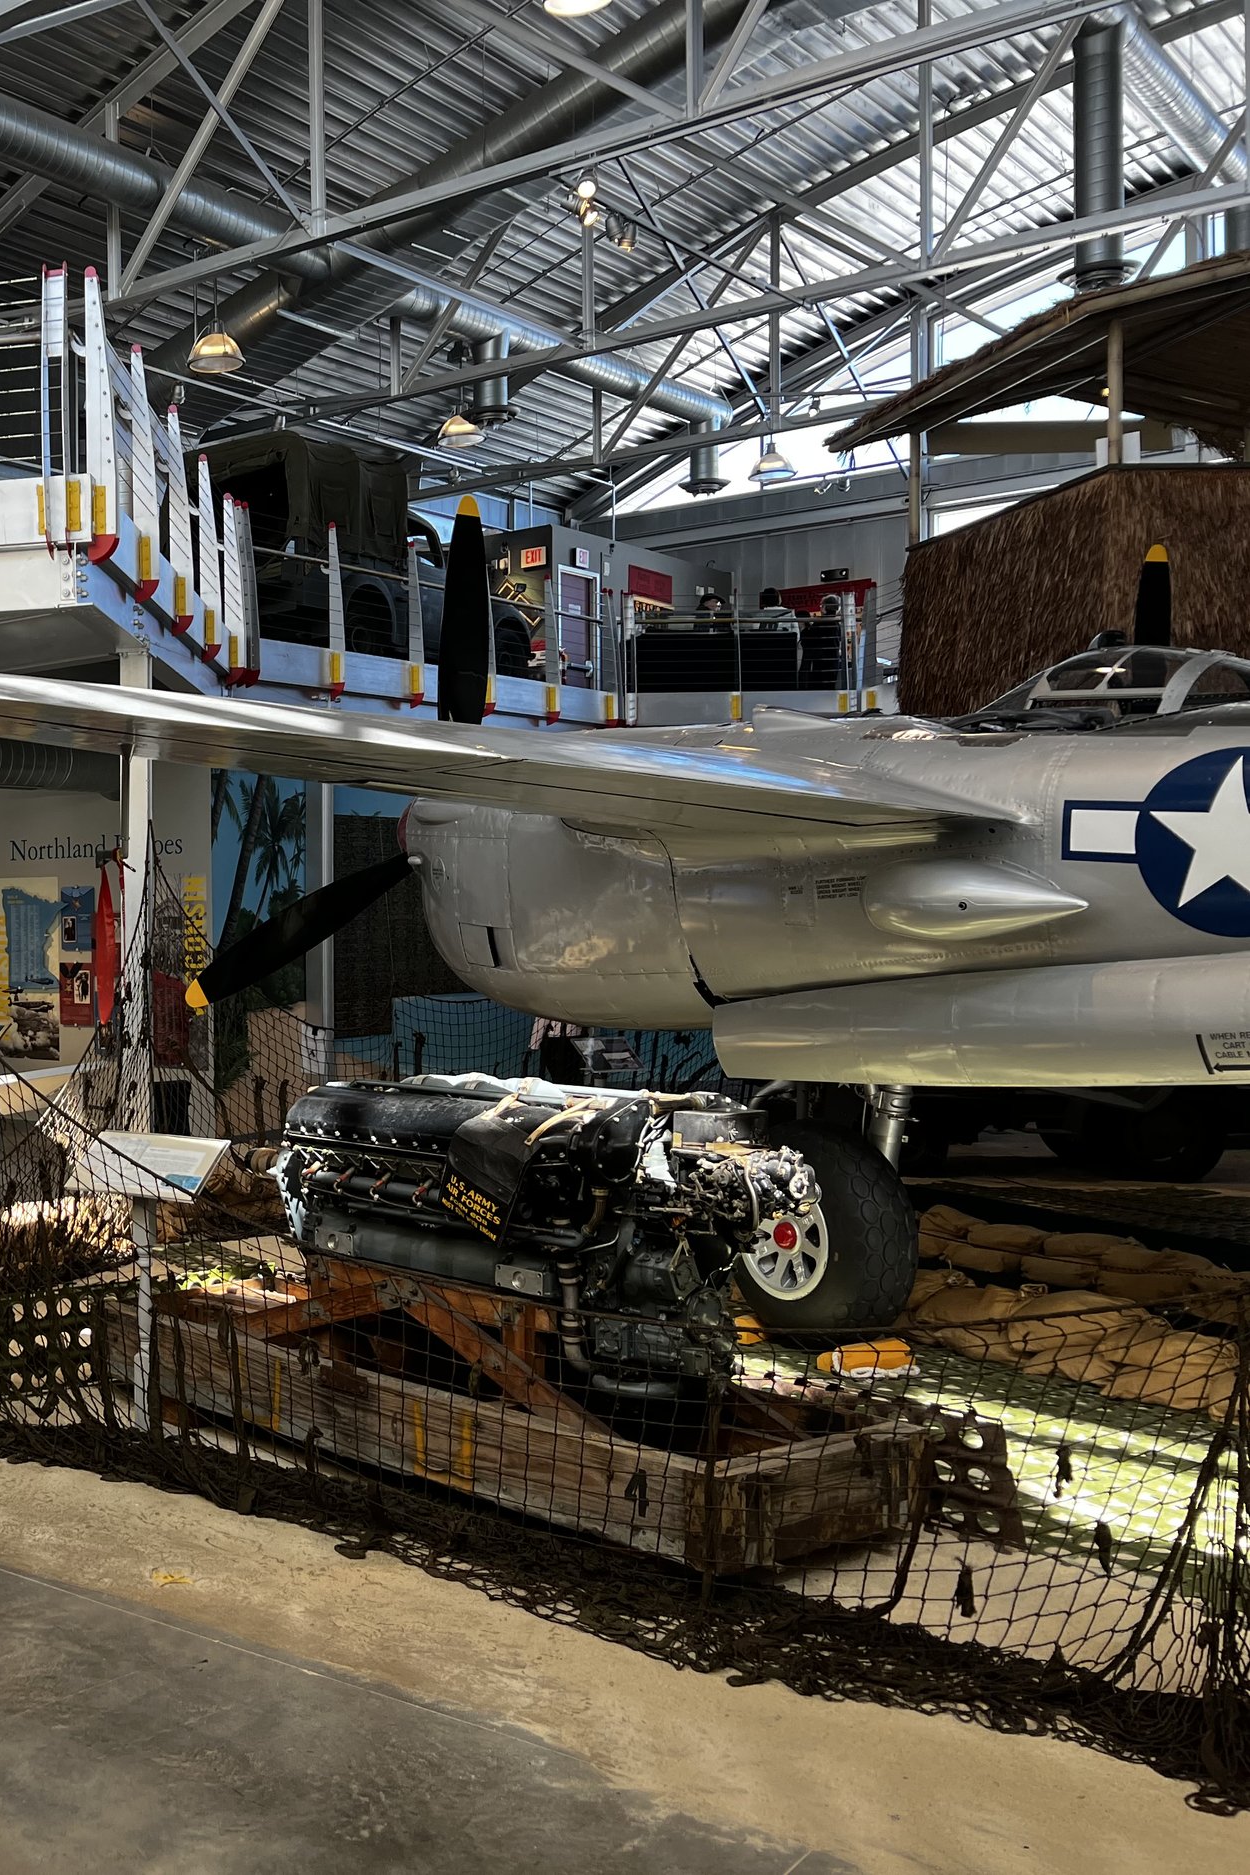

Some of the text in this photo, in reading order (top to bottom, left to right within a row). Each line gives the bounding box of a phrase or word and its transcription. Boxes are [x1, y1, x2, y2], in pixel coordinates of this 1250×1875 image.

[525, 548, 542, 565] EXIT
[9, 834, 105, 861] Northland
[183, 875, 207, 1017] SCONSIN
[1210, 1032, 1236, 1040] WHEN
[1222, 1041, 1246, 1049] CART
[1215, 1050, 1244, 1058] CABLE
[446, 1183, 501, 1225] AIR FORCES
[450, 1174, 499, 1213] U.S. ARMY
